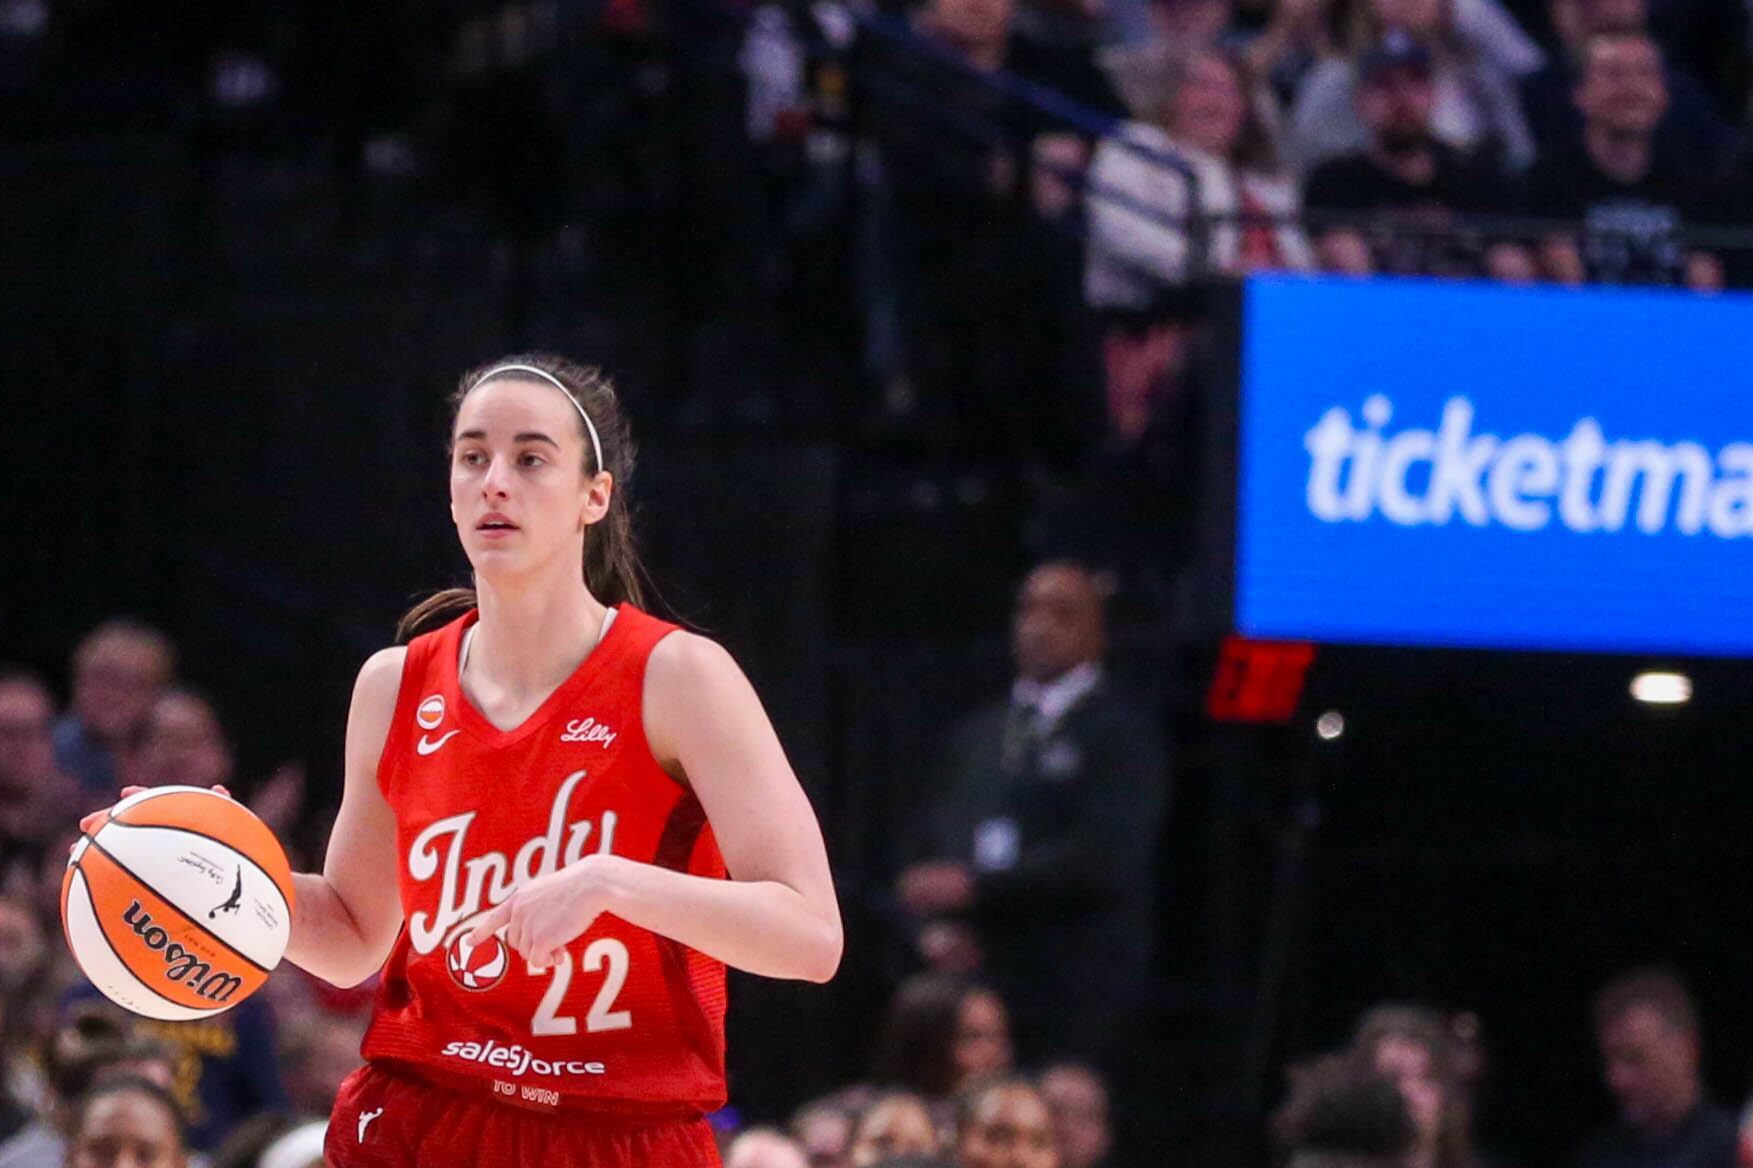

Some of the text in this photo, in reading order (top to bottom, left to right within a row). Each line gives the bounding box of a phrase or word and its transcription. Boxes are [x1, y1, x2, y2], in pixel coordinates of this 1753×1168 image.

[560, 717, 618, 749] Lilly
[122, 899, 242, 1003] Wilson
[527, 938, 632, 1037] 22
[441, 1038, 607, 1076] salesforce
[521, 1086, 560, 1106] WIN
